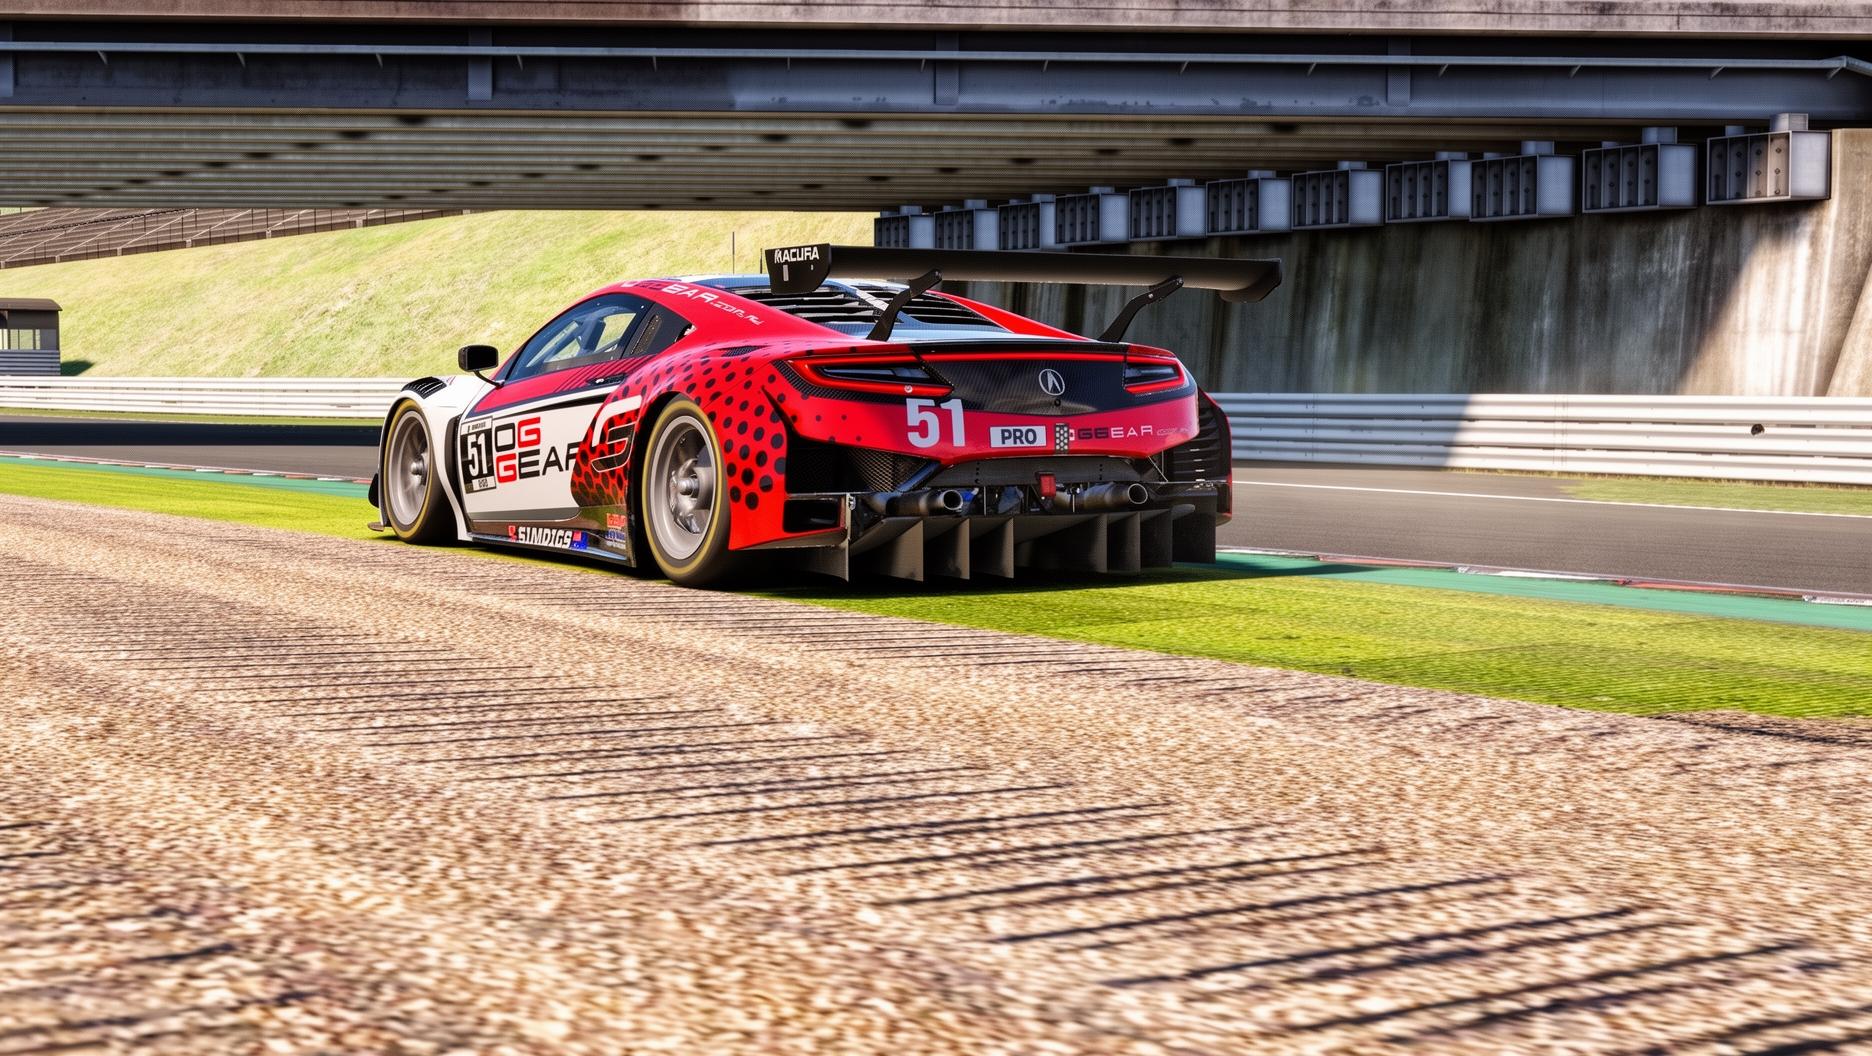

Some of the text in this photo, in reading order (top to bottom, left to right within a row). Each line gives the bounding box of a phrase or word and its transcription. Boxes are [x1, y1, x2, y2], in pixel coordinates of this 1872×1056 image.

[495, 416, 541, 452] OG
[906, 398, 966, 448] 51
[1001, 428, 1037, 445] PRO
[467, 432, 488, 477] 51
